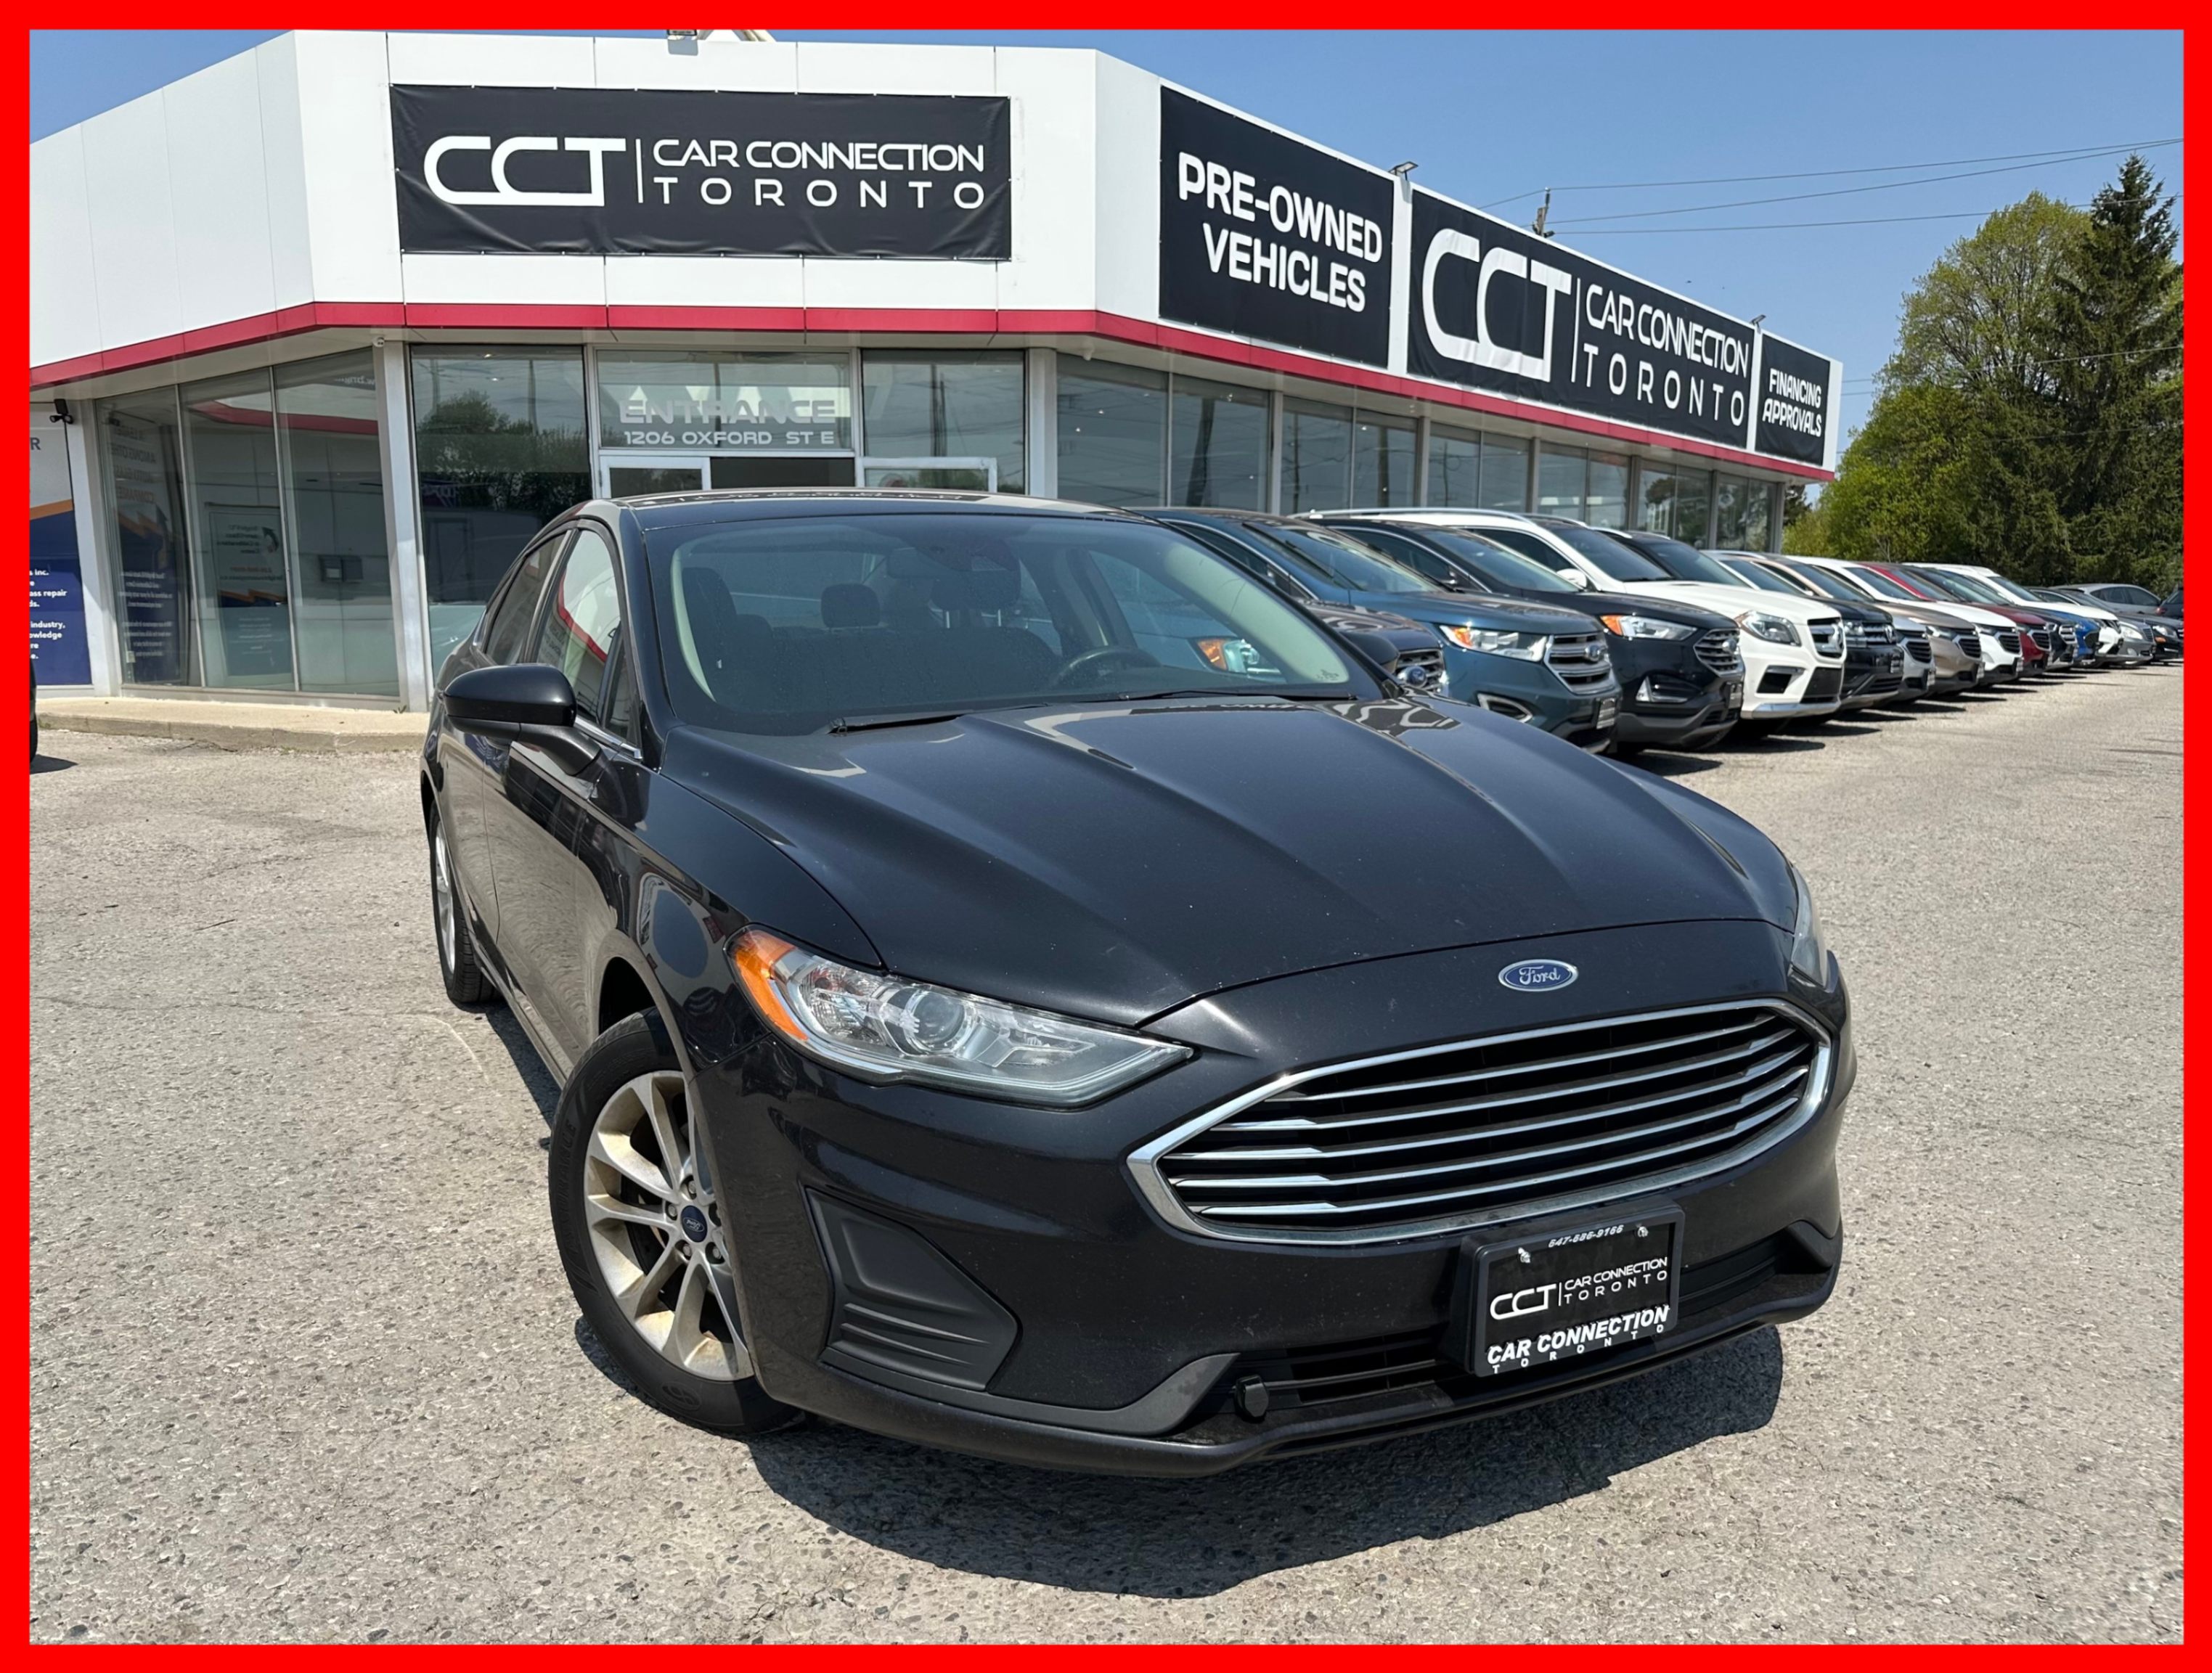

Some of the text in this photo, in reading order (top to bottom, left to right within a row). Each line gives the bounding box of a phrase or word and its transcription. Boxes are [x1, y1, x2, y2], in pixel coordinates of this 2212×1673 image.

[423, 136, 627, 207] CCT
[653, 139, 984, 172] CAR CONNECTION
[653, 176, 984, 209] TORONTO
[1178, 152, 1382, 263] PRE-OWNED
[1202, 222, 1366, 312] VEHICLES
[1422, 228, 1572, 383] CCT
[1585, 284, 1749, 378] CAR CONNECTION
[1583, 343, 1744, 427] TORONTO
[1769, 368, 1822, 409] FINANCING
[619, 399, 836, 425] ENTRANCE
[1763, 398, 1822, 437] APPROVALS
[624, 431, 835, 445] 1206 OXFORD ST E
[43, 589, 68, 599] repair
[30, 620, 66, 629] industry,
[1518, 965, 1562, 986] Ford
[1564, 1256, 1668, 1290] CAR CONNECTION
[1564, 1270, 1668, 1304] TORONTO
[1490, 1283, 1557, 1320] CCT
[1487, 1304, 1670, 1365] CAR CONNECTION
[1492, 1324, 1664, 1374] TORONTO
